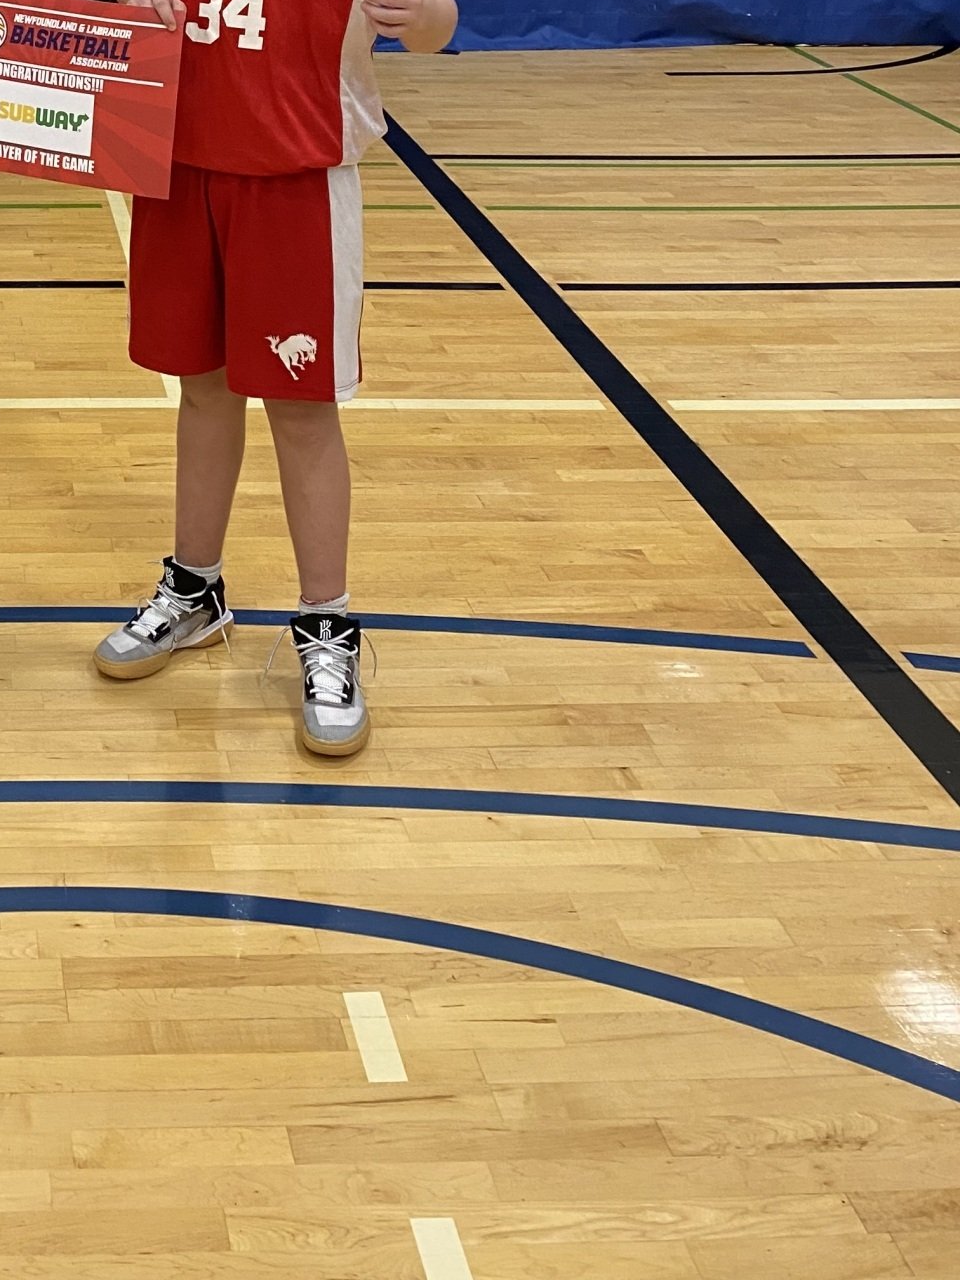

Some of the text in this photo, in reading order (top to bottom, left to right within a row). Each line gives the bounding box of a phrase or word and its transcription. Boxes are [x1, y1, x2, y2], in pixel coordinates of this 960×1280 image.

[14, 13, 132, 39] NEWFOUNDLAND & LABRADOR
[10, 25, 132, 61] BASKETBALL
[69, 55, 129, 73] ASSOCIATION
[23, 149, 38, 164] OF
[40, 151, 60, 169] THE
[61, 156, 95, 175] GAME
